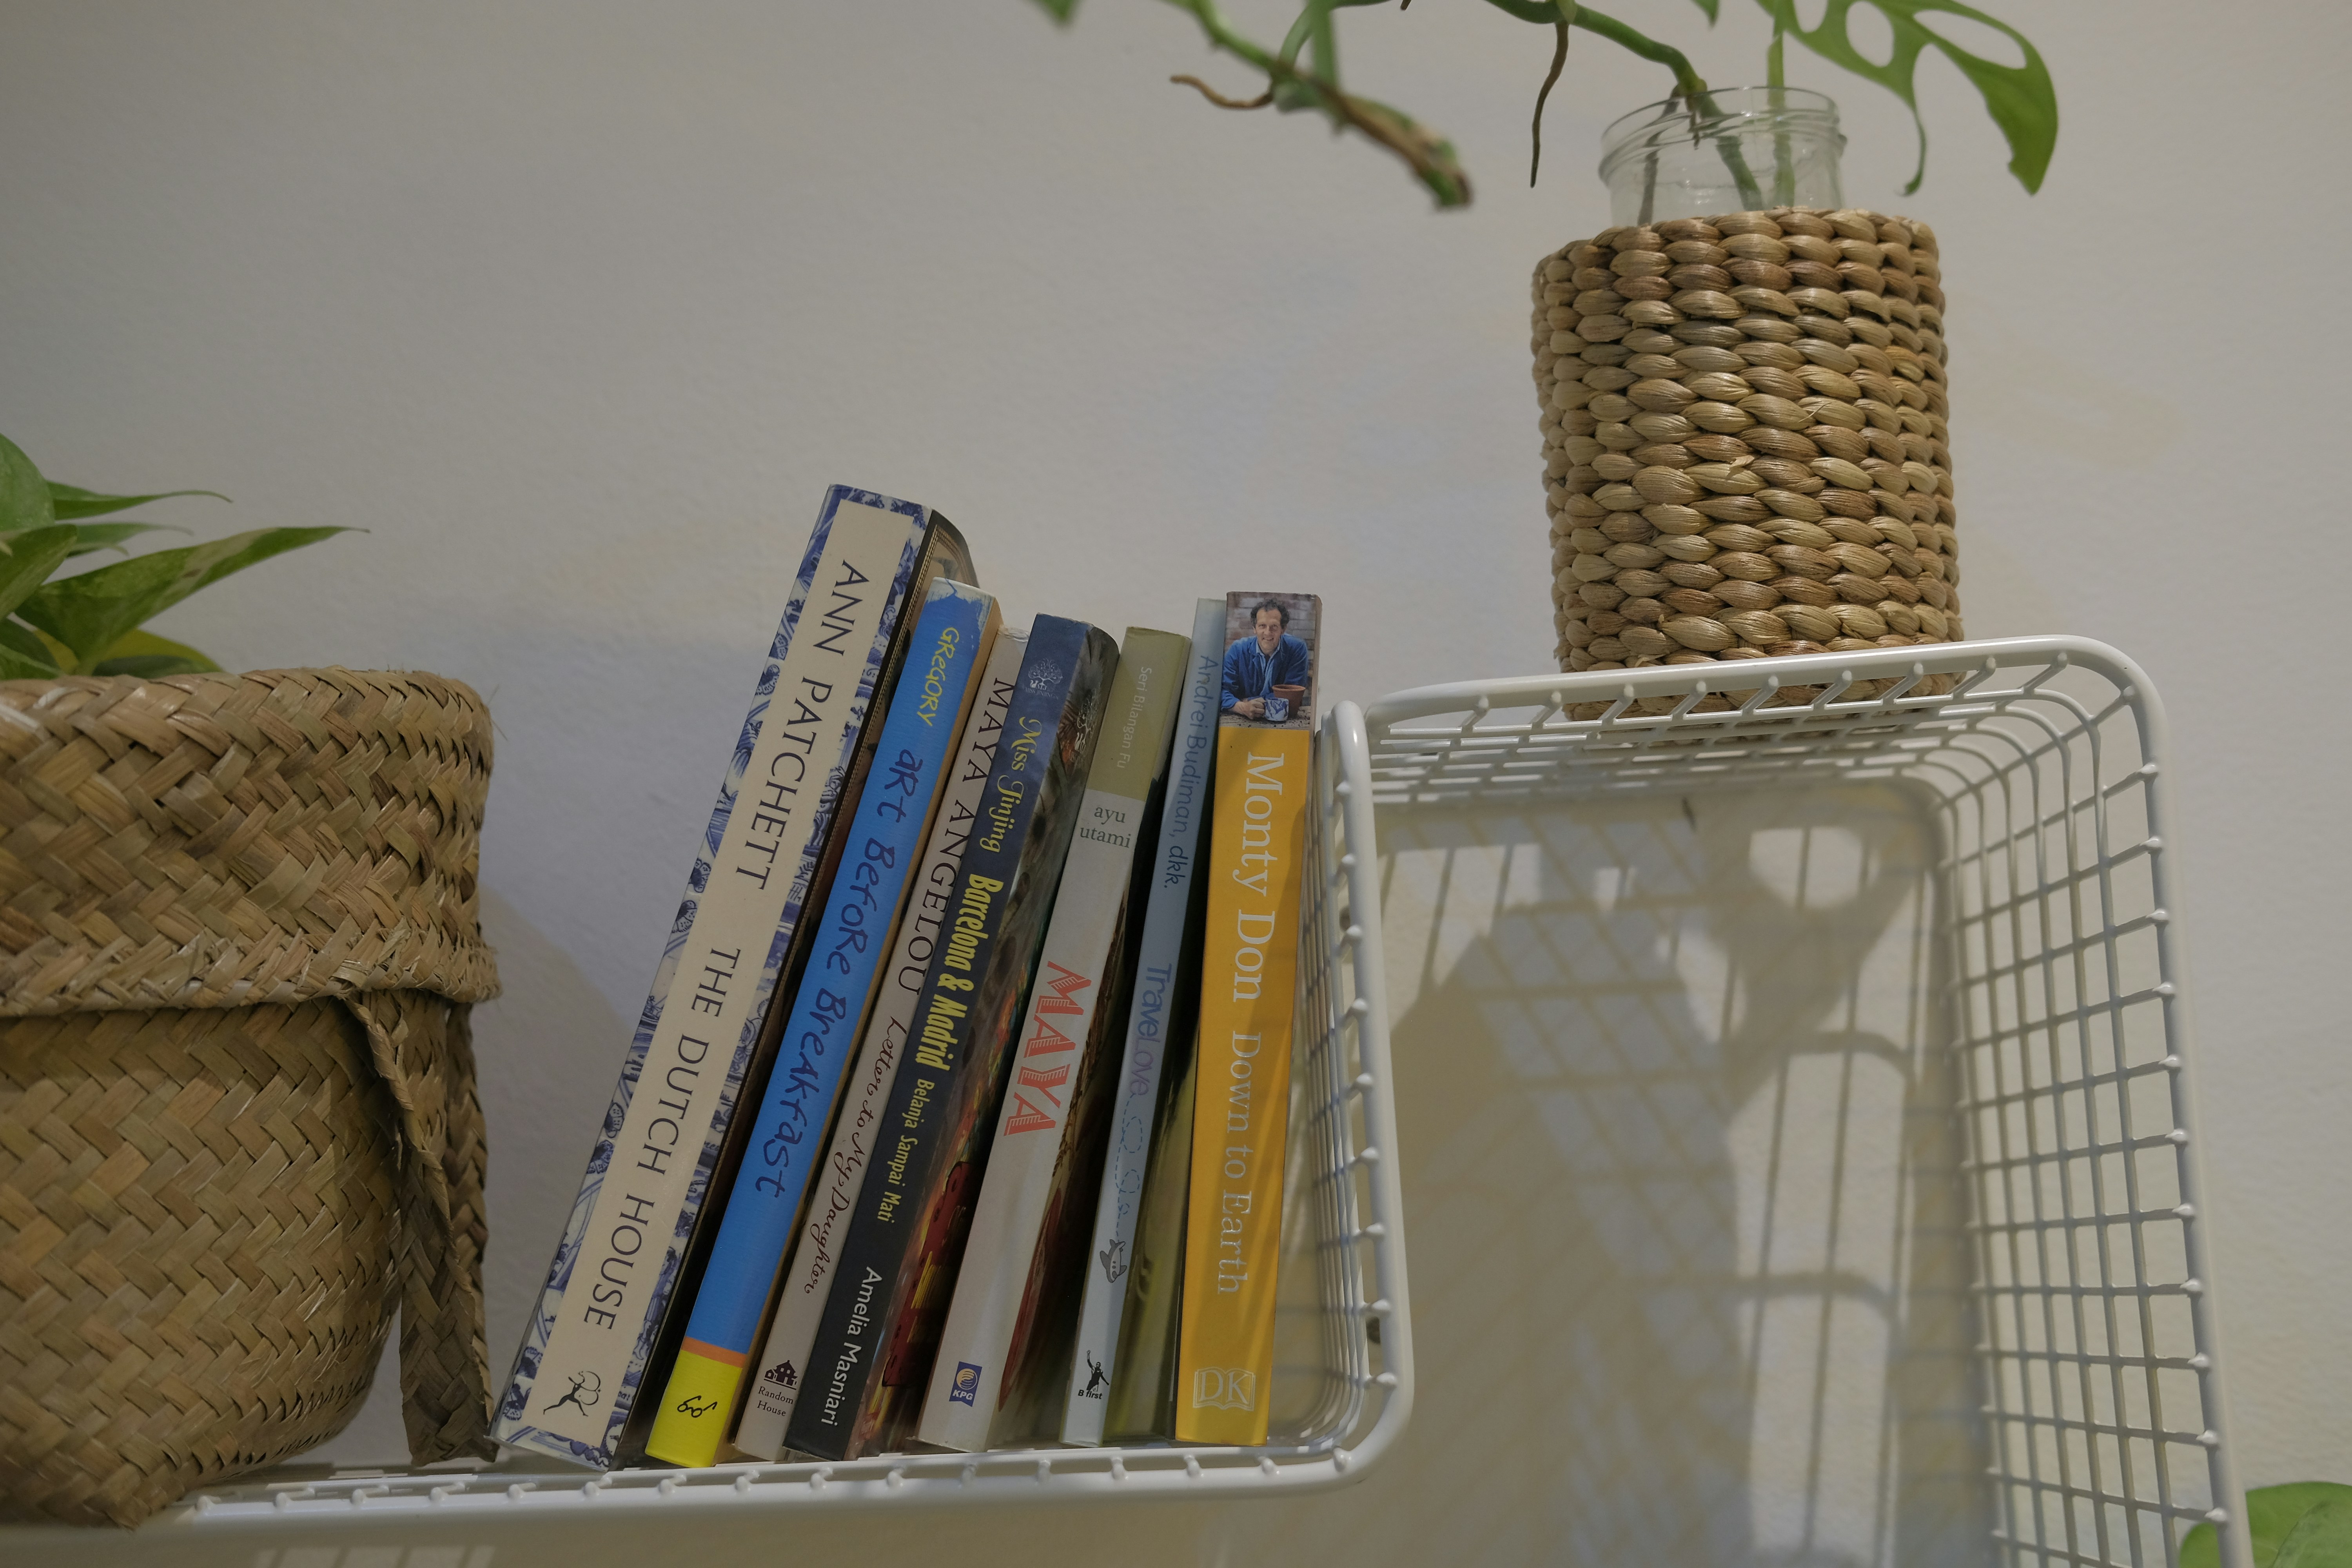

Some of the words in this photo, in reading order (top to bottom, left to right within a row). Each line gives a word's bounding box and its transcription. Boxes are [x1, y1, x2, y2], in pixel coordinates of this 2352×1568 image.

[813, 559, 869, 656] ANN
[1137, 667, 1152, 691] Seri
[1189, 655, 1219, 728] Andrei
[962, 677, 1015, 782] MAYA
[1011, 716, 1042, 771] Miss
[1123, 695, 1145, 748] Bilangan
[737, 677, 834, 890] PATCHETT
[1117, 753, 1131, 768] Fu
[1169, 734, 1207, 837] Budiman,
[980, 775, 1024, 853] Jinjing
[1080, 824, 1131, 849] utami
[1094, 805, 1126, 825] ayu
[1232, 751, 1285, 897] Monty
[898, 799, 975, 995] ANGELOU
[1164, 846, 1188, 888] dkk.
[944, 873, 1004, 971] Barcelona
[1233, 909, 1275, 1003] Don
[691, 948, 741, 1018] THE
[939, 973, 974, 992] &
[867, 1016, 907, 1096] Letter
[915, 994, 967, 1071] Madrid
[1003, 961, 1091, 1136] MAYA
[637, 1034, 710, 1175] DUTCH
[857, 1100, 873, 1127] to
[902, 1078, 935, 1129] Belanja
[1227, 1030, 1261, 1133] Down
[834, 1132, 865, 1187] My
[887, 1135, 918, 1187] Sampai
[1224, 1144, 1254, 1179] to
[805, 1186, 851, 1294] Daughter
[877, 1191, 902, 1223] Mati
[584, 1193, 655, 1330] HOUSE
[1217, 1189, 1252, 1295] Earth
[848, 1267, 882, 1336] Amelia
[757, 1400, 786, 1416] House
[758, 1386, 793, 1404] Random
[821, 1342, 862, 1427] Masniari
[952, 1389, 974, 1401] KPG
[1086, 1390, 1102, 1399] first
[1199, 1370, 1249, 1404] DK
